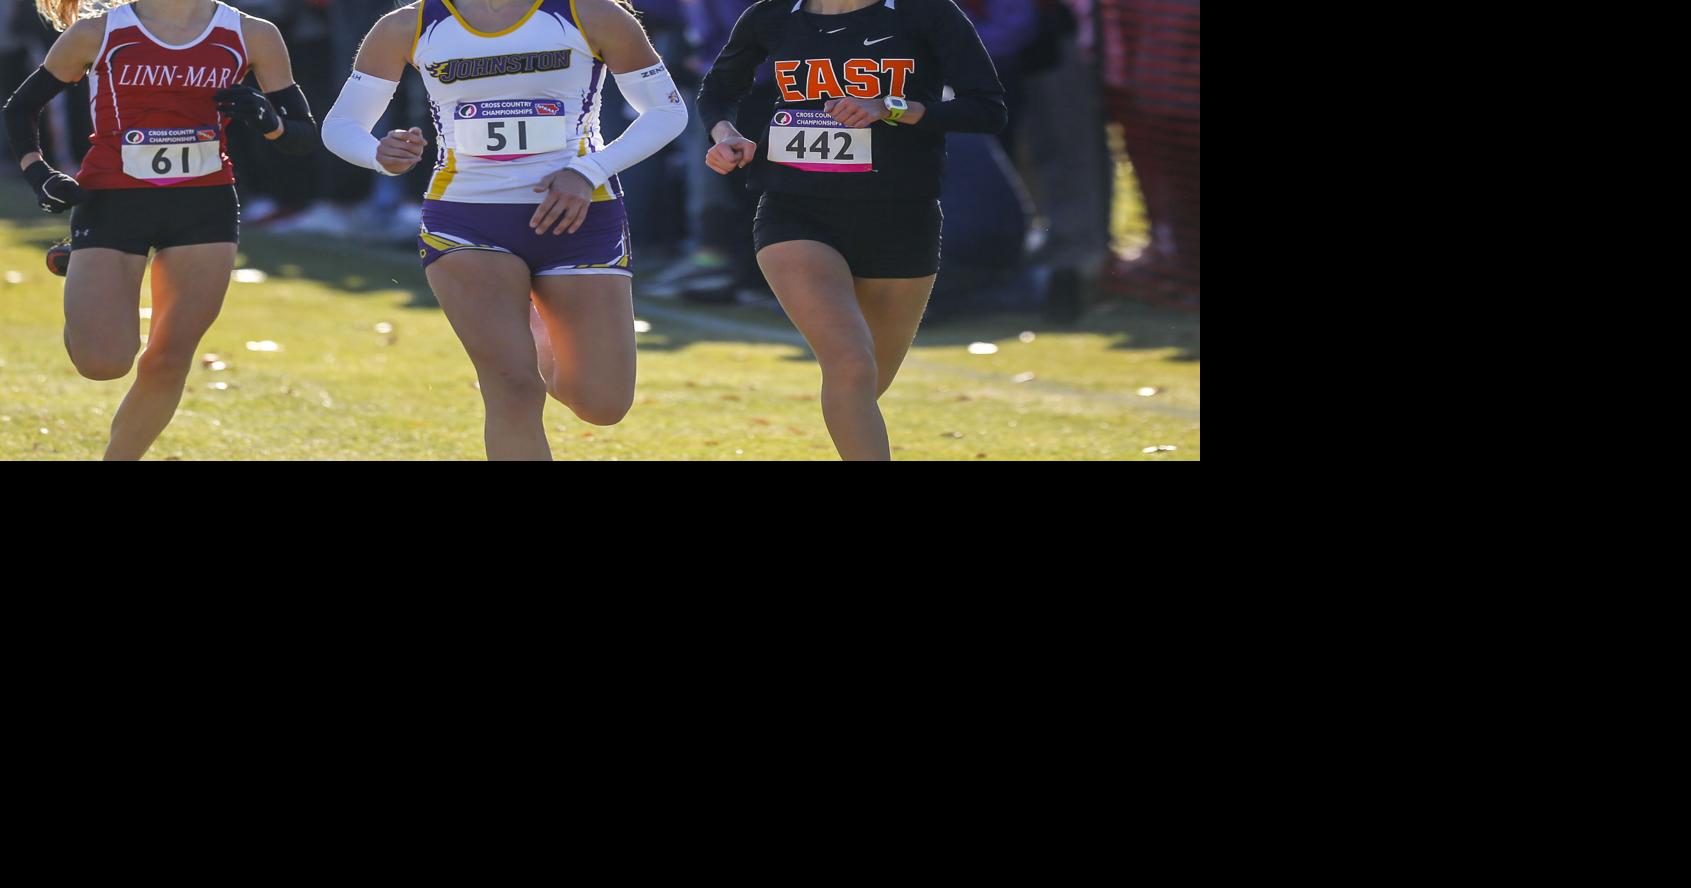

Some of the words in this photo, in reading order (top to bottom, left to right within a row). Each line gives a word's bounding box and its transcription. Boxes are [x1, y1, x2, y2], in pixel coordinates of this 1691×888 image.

[119, 64, 231, 88] LINN-MAR
[439, 49, 571, 84] JOHNSTON
[774, 58, 914, 102] EAST
[481, 108, 533, 116] CHAMPIONSHIPS
[486, 120, 527, 151] 51
[785, 130, 854, 160] 442
[151, 147, 190, 174] 61
